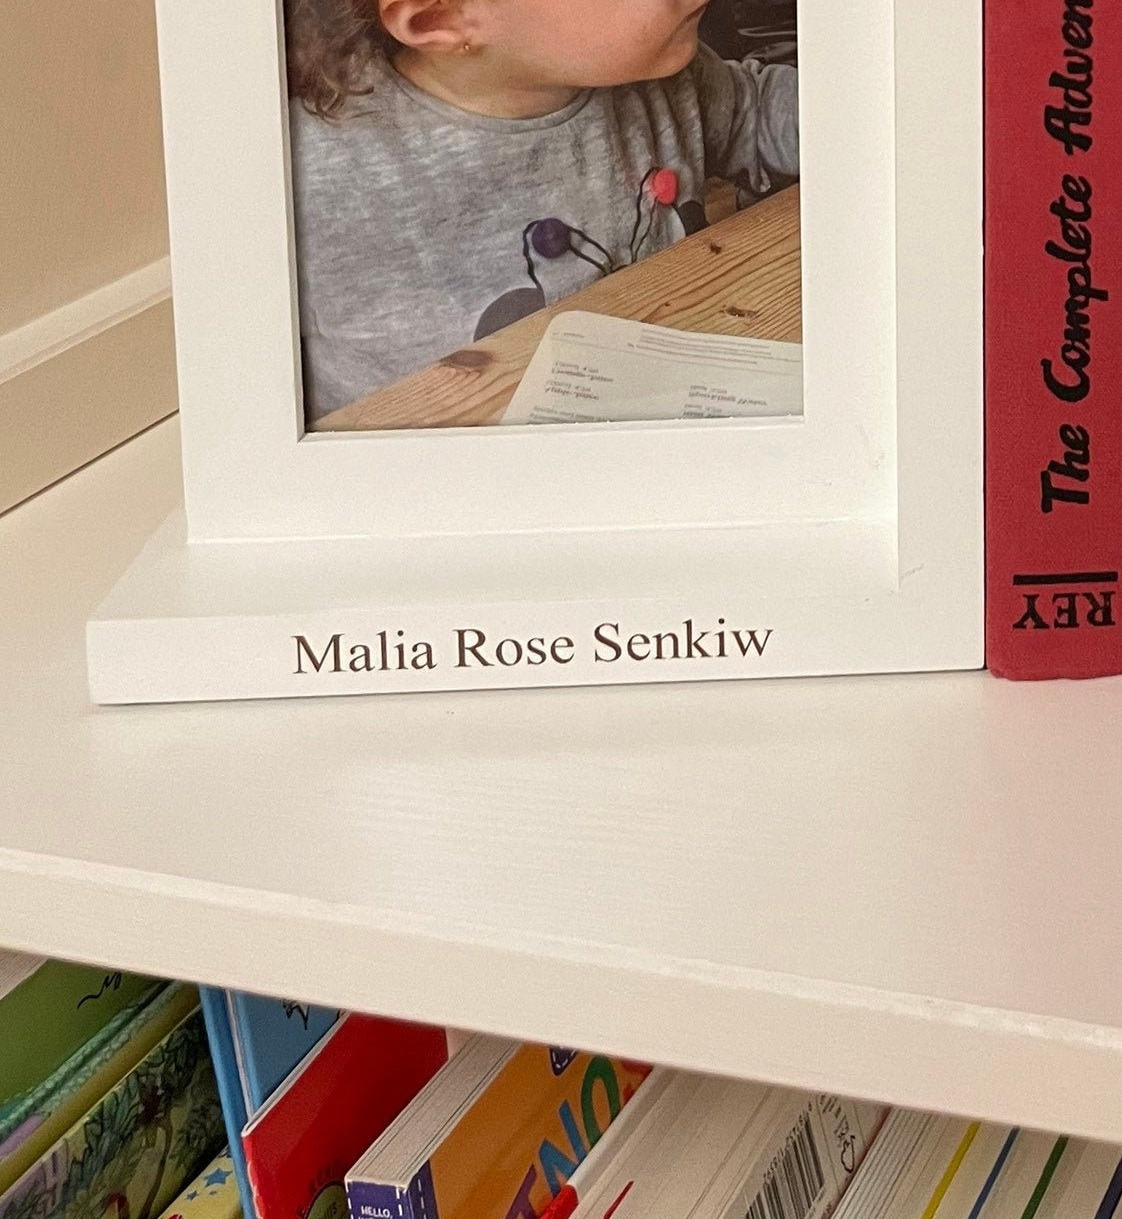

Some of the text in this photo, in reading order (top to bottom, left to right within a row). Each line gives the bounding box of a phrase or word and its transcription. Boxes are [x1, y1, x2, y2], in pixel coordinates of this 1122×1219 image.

[1039, 173, 1109, 404] Complete
[1039, 423, 1091, 515] The
[292, 617, 774, 674] Malia Rose Senkiw
[1012, 590, 1117, 630] REY
